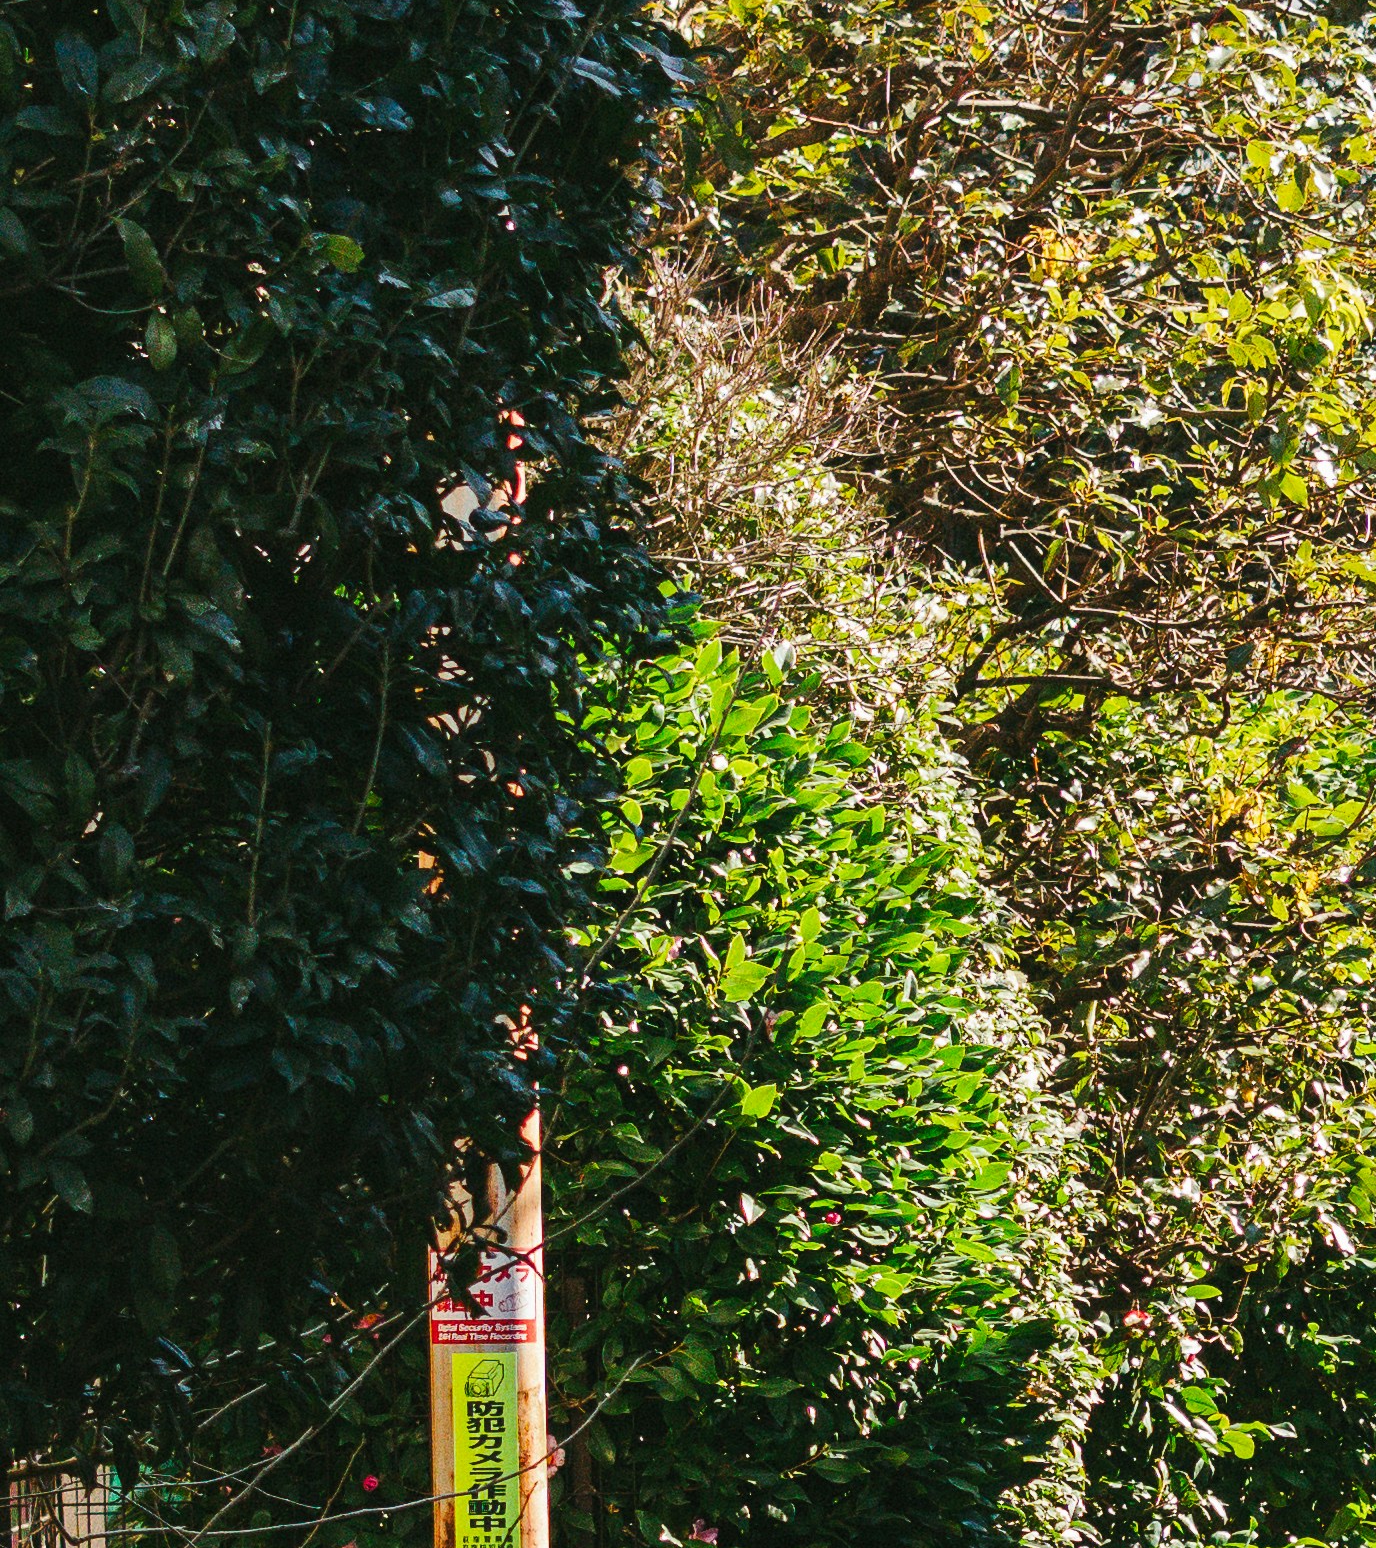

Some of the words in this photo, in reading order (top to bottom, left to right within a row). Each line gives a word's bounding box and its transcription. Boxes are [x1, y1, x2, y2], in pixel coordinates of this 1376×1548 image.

[458, 1323, 493, 1333] Security
[466, 1400, 506, 1533] 防犯カメラ作動中
